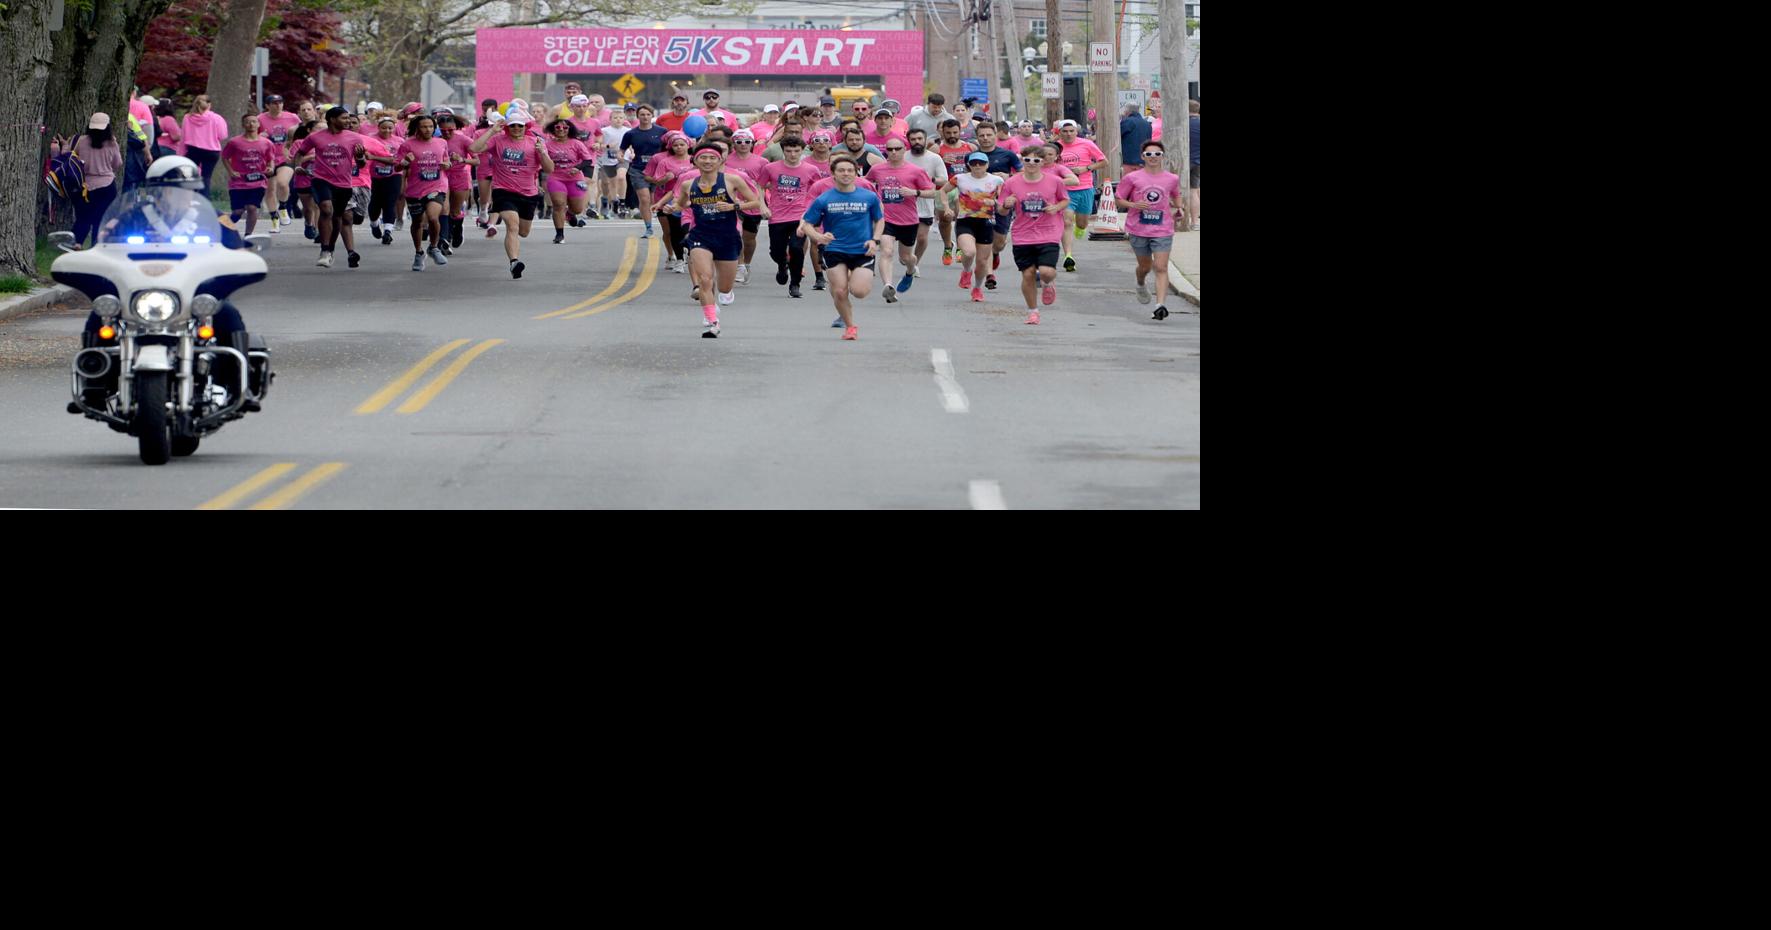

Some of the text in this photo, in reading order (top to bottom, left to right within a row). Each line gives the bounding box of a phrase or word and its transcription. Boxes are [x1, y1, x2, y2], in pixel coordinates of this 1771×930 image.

[544, 36, 659, 49] STEP UP FOR
[544, 49, 660, 67] COLLEEN
[663, 36, 723, 66] 5K
[721, 36, 876, 66] START
[1096, 48, 1109, 57] NO
[1102, 186, 1111, 196] O
